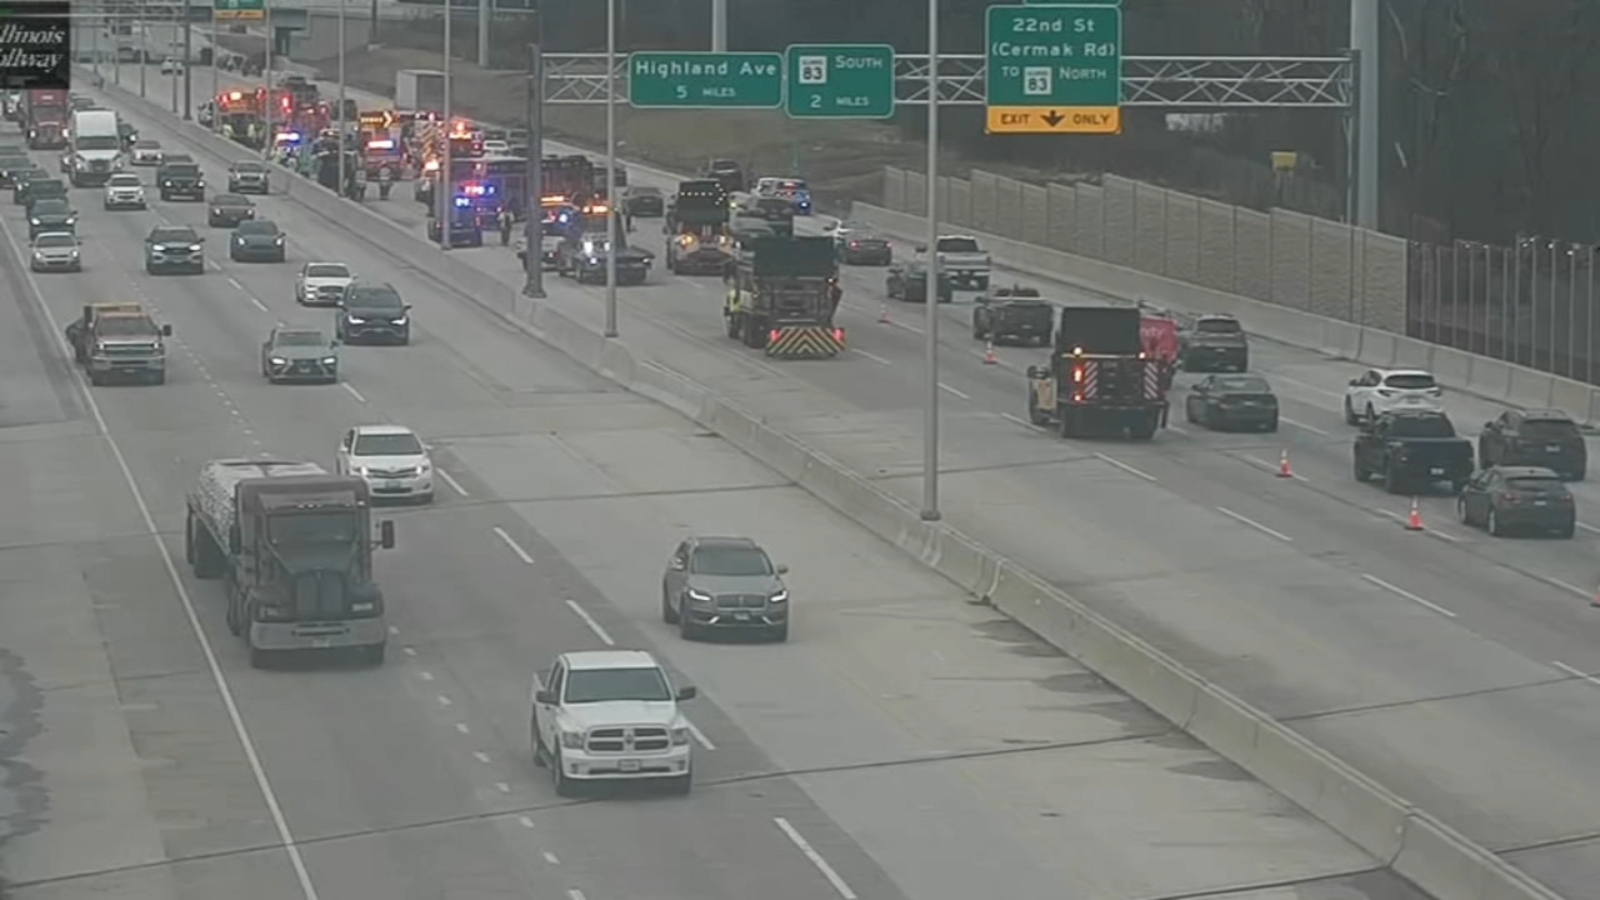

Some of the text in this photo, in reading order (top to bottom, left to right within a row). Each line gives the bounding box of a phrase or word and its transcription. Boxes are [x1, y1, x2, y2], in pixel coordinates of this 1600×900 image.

[1013, 18, 1094, 32] 22nd St
[992, 42, 1115, 56] (Cermak Rd)
[635, 61, 777, 79] Highland Ave
[803, 66, 823, 80] 83
[1002, 66, 1019, 77] TO
[1028, 78, 1048, 91] 83
[676, 84, 736, 99] 5 MILES
[810, 94, 869, 108] 2 MILES
[1001, 113, 1110, 125] EXIT ONLY
